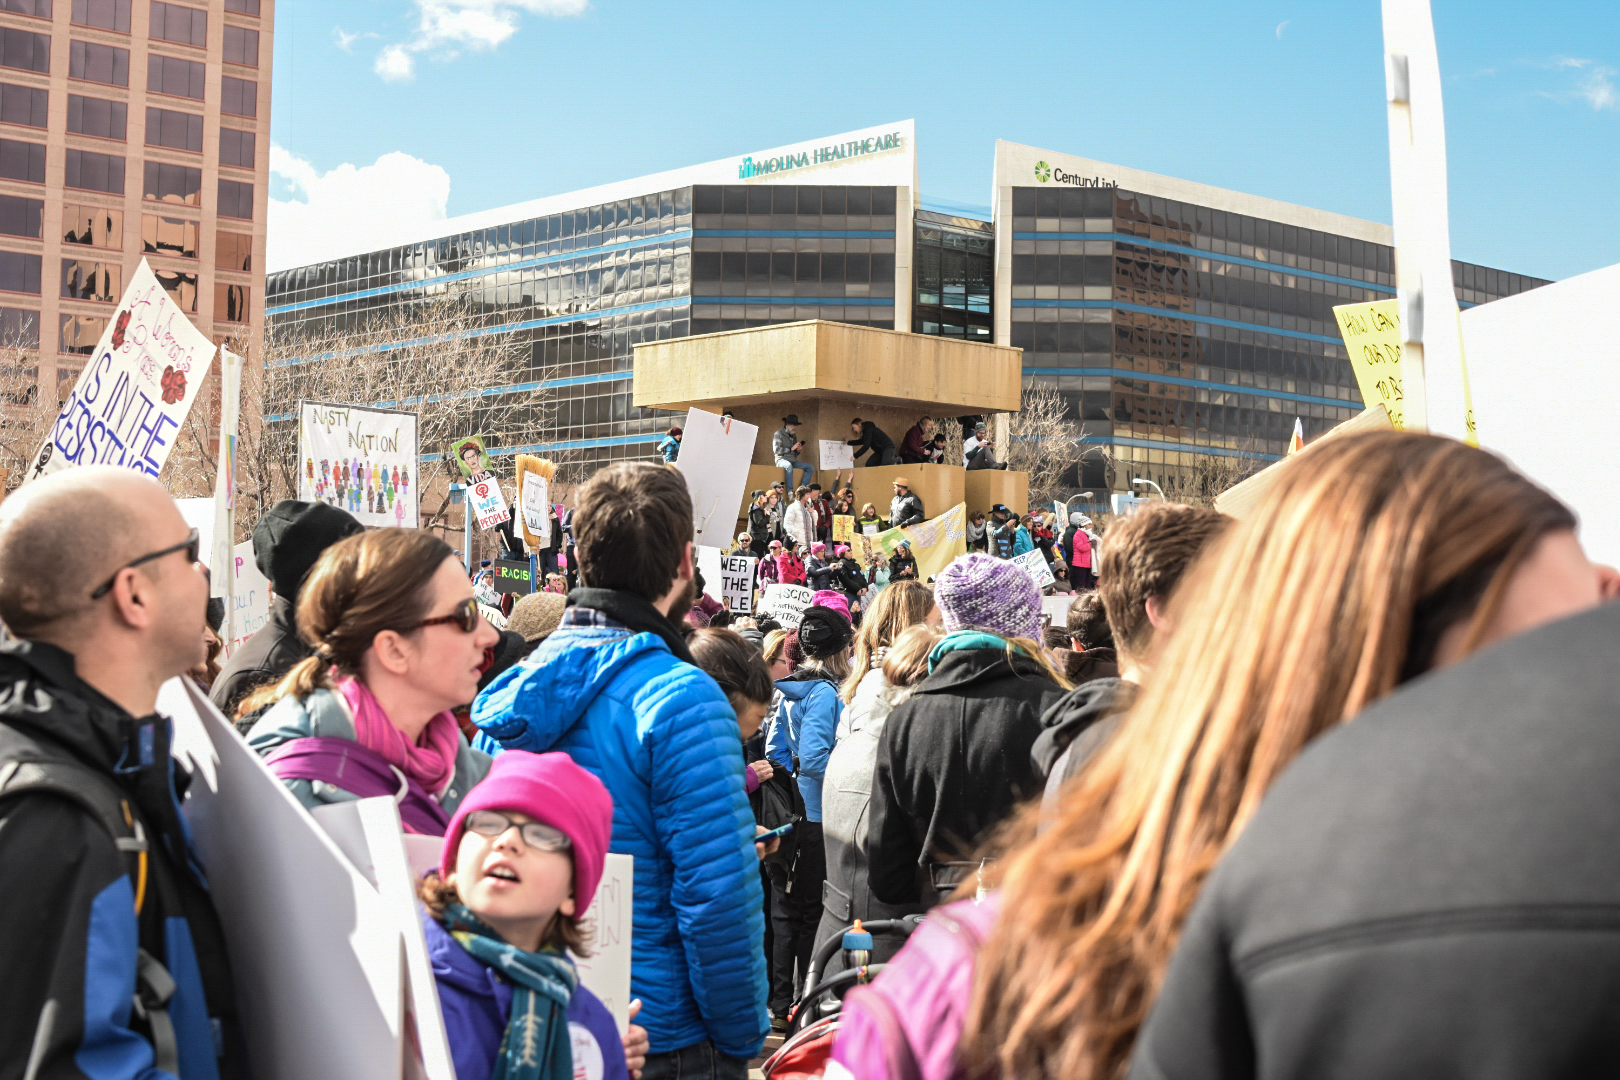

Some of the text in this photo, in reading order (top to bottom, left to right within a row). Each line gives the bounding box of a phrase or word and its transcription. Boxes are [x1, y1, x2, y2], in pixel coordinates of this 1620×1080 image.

[756, 132, 901, 176] MOLINA HEALTHCARE
[1054, 167, 1119, 188] CenturyLink
[80, 346, 112, 404] IS
[126, 391, 178, 469] THE
[313, 402, 351, 434] NASTY
[348, 421, 399, 457] NATION
[467, 470, 492, 485] VIDA
[477, 496, 499, 510] WE
[480, 510, 510, 528] PEOPLE
[723, 577, 749, 592] THE
